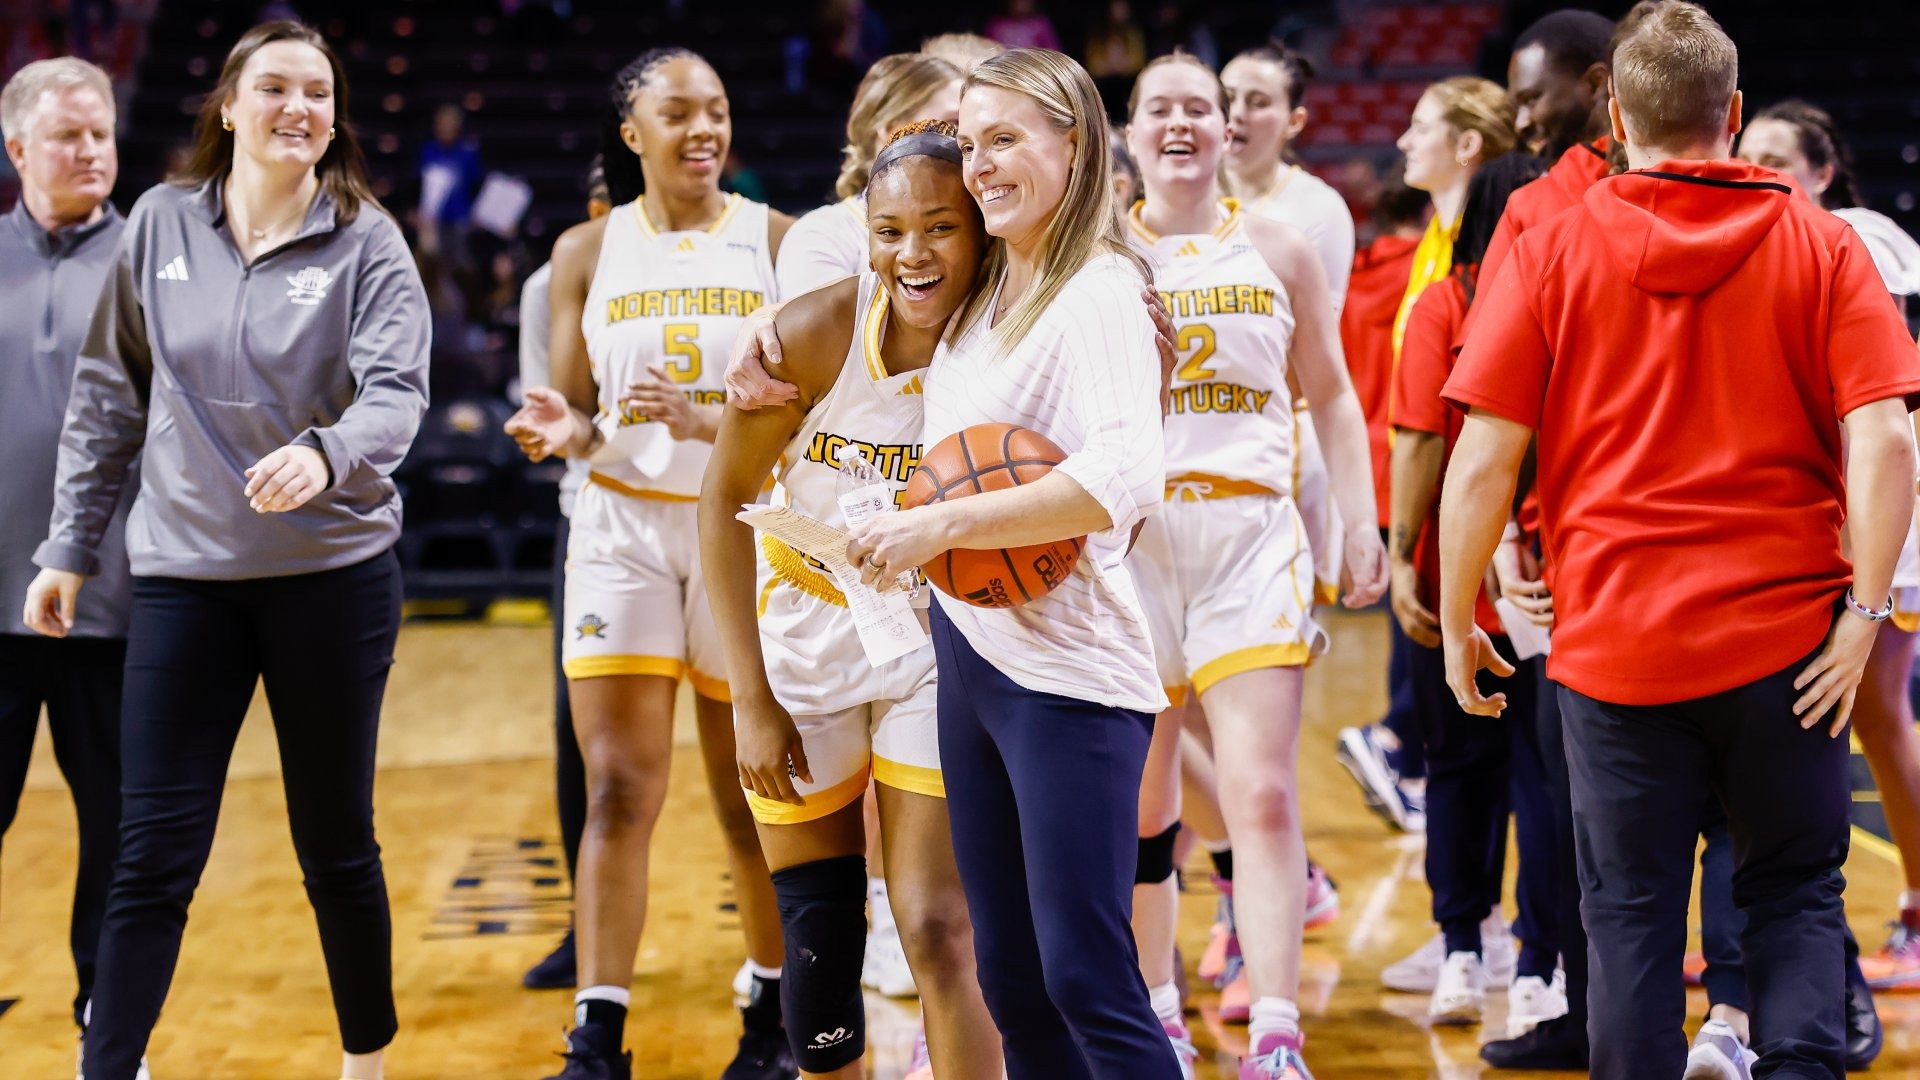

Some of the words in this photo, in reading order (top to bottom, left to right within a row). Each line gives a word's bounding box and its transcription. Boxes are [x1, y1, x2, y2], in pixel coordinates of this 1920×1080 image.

[607, 287, 763, 326] NORTHERN
[664, 323, 702, 384] 5
[1176, 323, 1216, 381] 2
[1165, 382, 1272, 416] TUCKY
[803, 431, 923, 482] NORTH
